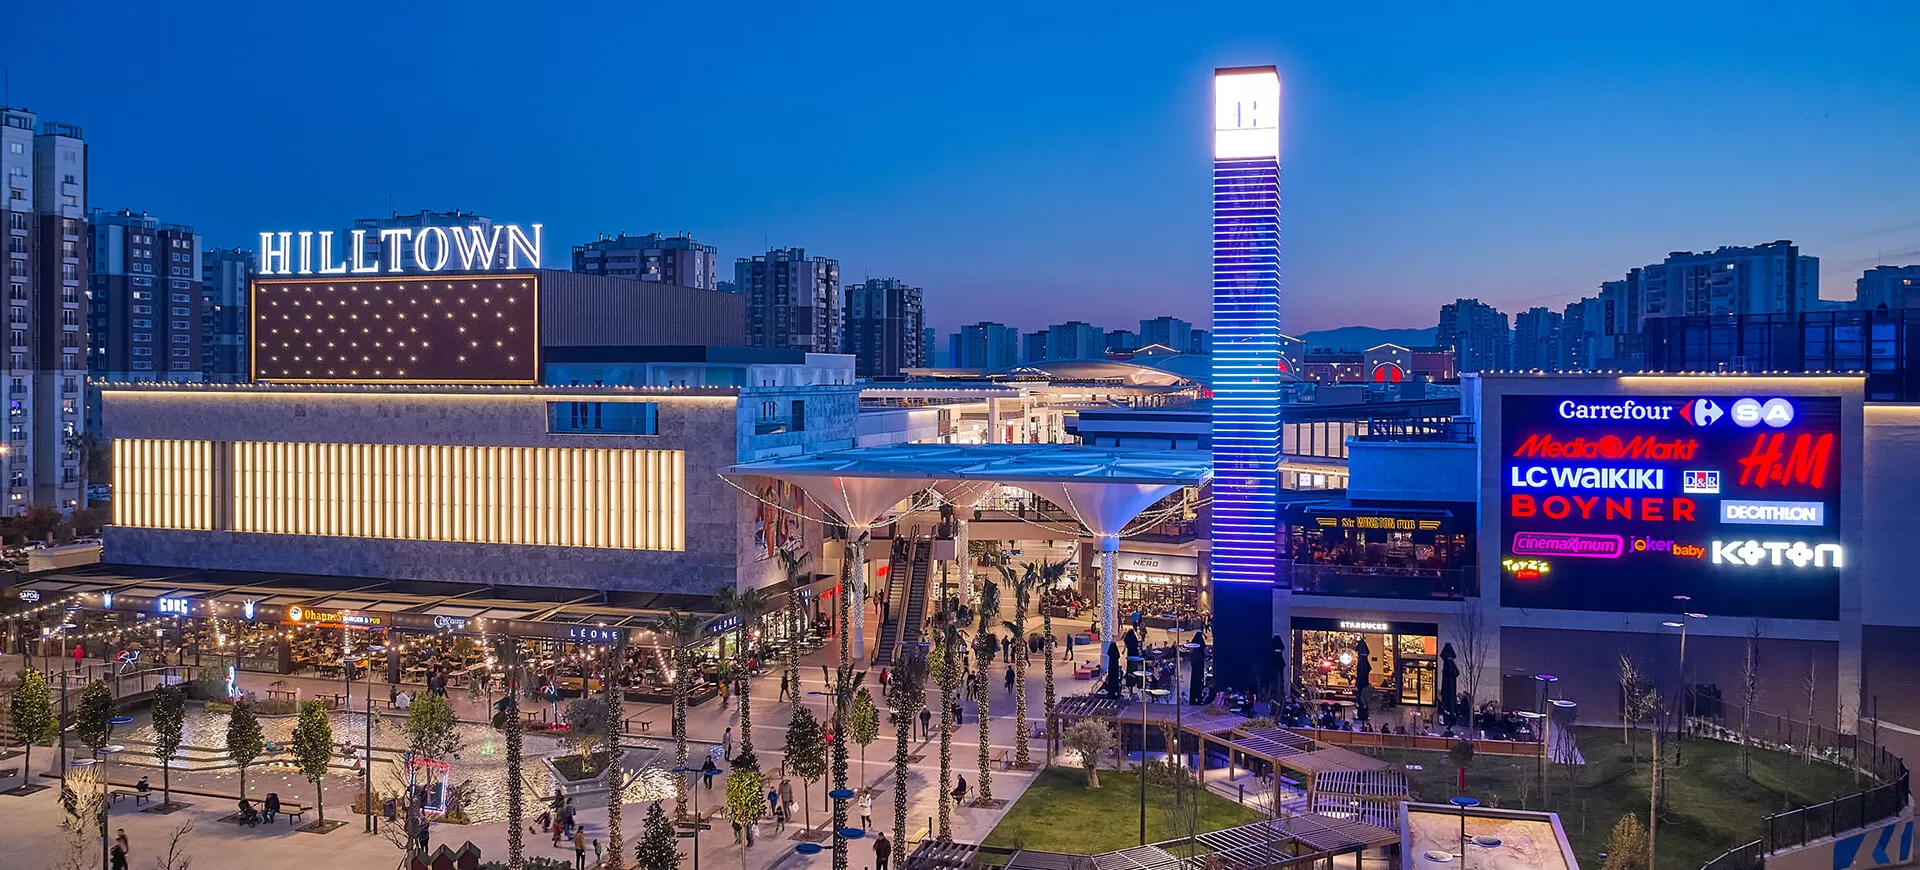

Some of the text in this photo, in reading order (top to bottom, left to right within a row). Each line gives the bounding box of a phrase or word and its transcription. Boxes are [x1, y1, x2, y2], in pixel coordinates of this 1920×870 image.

[259, 224, 543, 274] HILLTOWN
[1559, 400, 1672, 420] Carrefour
[1738, 433, 1833, 489] H&M
[1512, 467, 1548, 489] LC
[1684, 474, 1718, 489] D&R
[1512, 494, 1696, 521] BOYNER
[1726, 504, 1816, 521] DECATHLON
[1628, 535, 1675, 553] joker
[1673, 544, 1705, 558] baby
[1133, 559, 1159, 568] NERO
[570, 628, 618, 640] LÉONE
